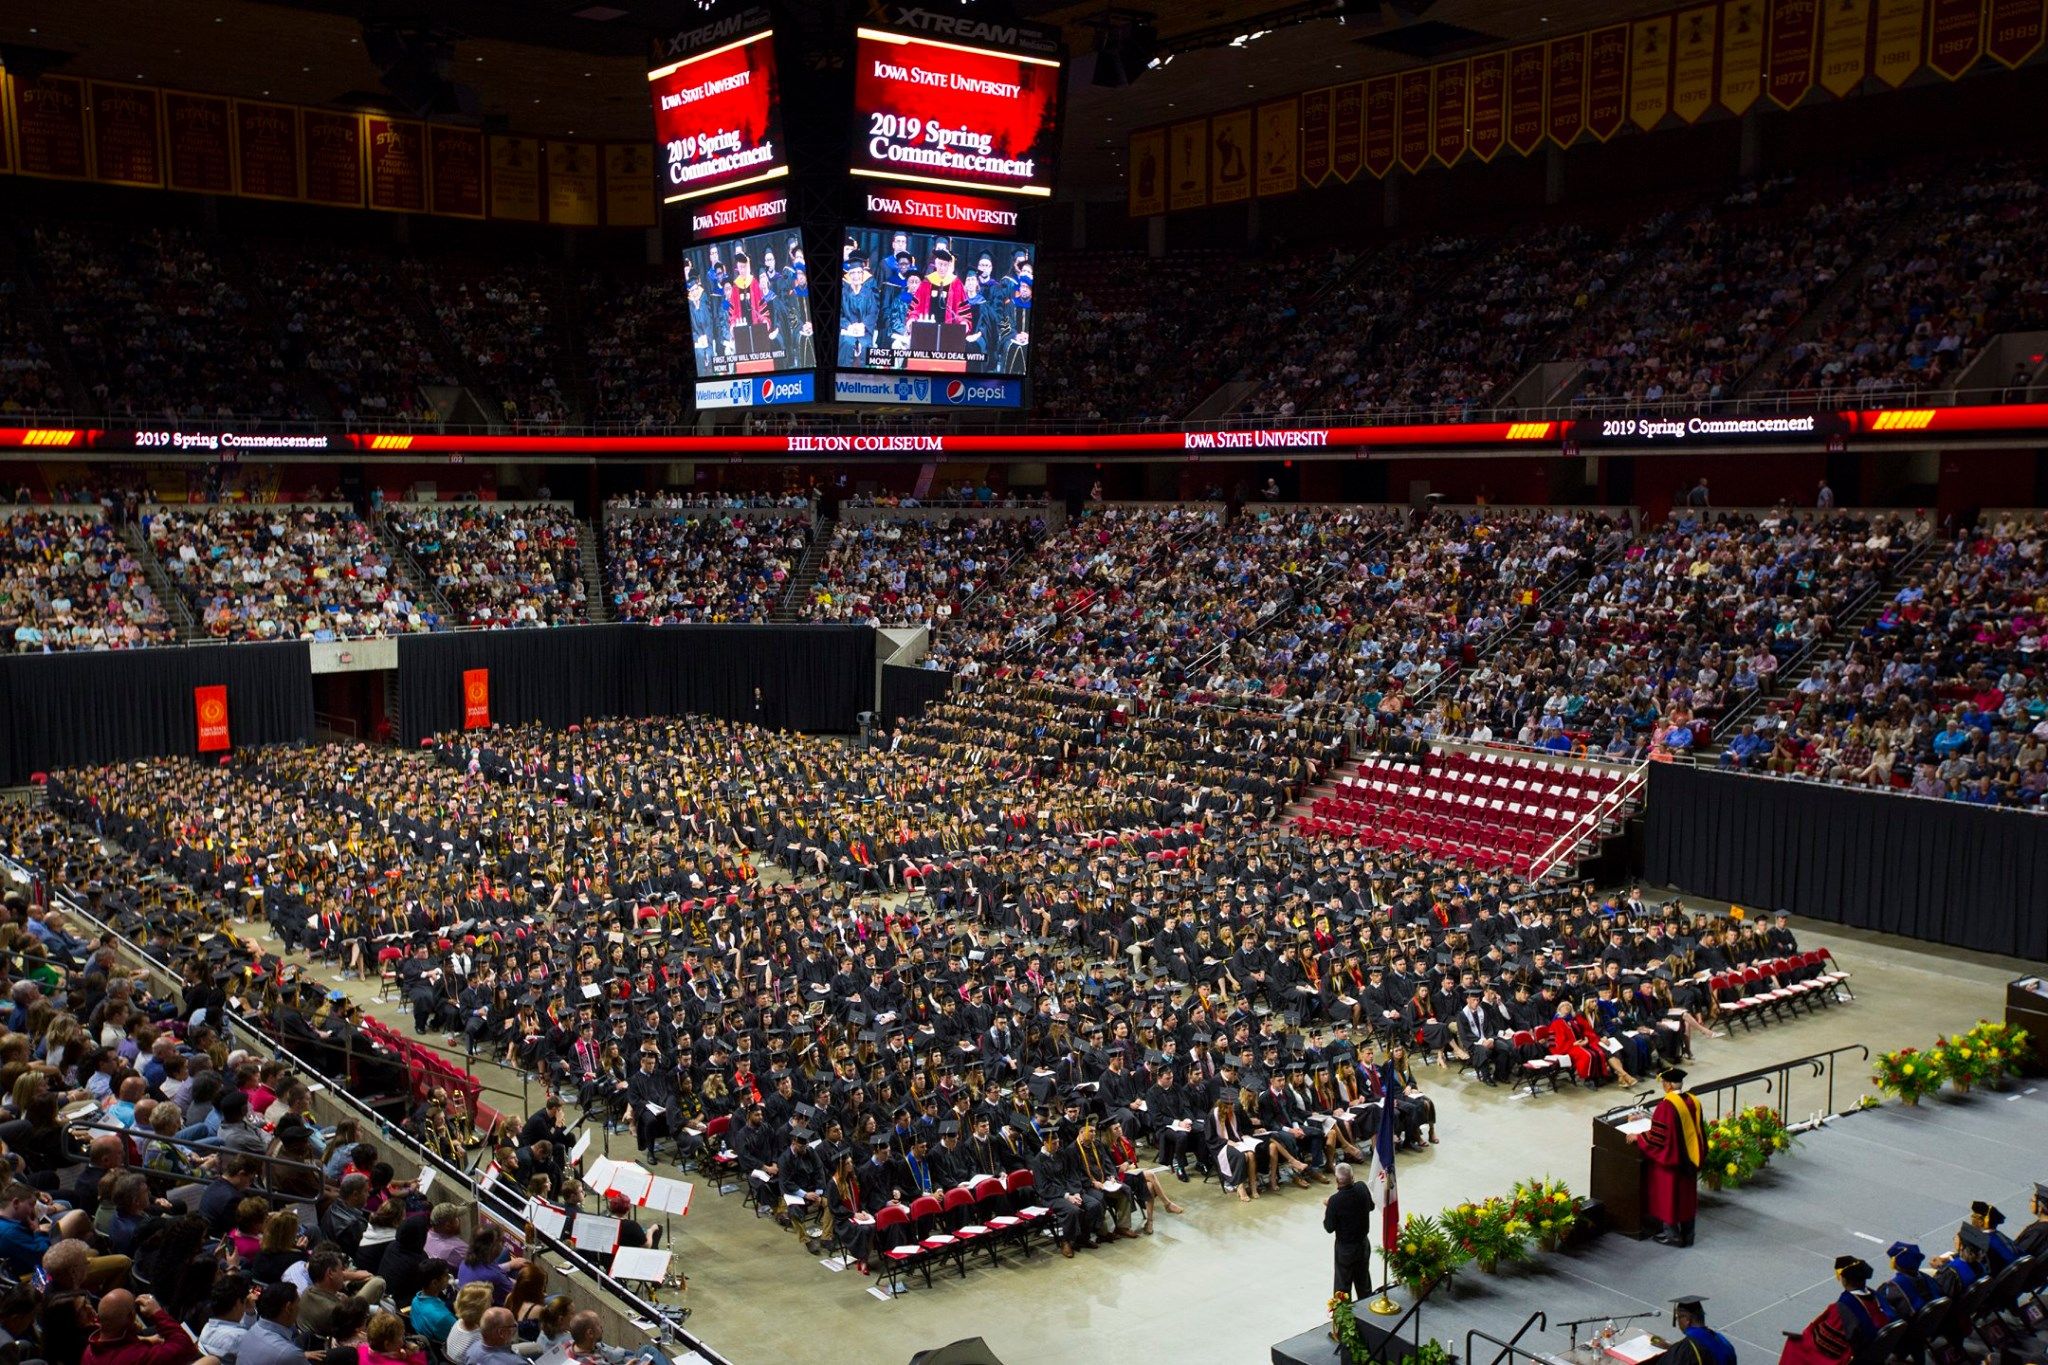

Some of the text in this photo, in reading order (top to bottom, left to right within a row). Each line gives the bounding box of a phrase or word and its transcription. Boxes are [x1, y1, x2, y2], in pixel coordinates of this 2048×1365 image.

[667, 13, 742, 56] XTREAM
[894, 7, 1018, 46] XTREAM
[1998, 24, 2039, 42] 1989
[1938, 36, 1974, 55] 1987
[874, 60, 1021, 99] IOWA STATE UNIVERSITY
[1774, 71, 1806, 87] 1977
[661, 70, 751, 111] IOWA STATE UNIVERSITY
[869, 112, 993, 155] 2019 Spring
[667, 128, 742, 164] 2019 Spring
[670, 140, 774, 184] Commencement
[869, 137, 1035, 178] Commencement
[692, 198, 787, 231] IOWA STATE UNIVERSITY
[867, 194, 1018, 226] IOWA STATE UNIVERSITY
[869, 348, 985, 361] FIRST, HOW WILL YOU DEAL WITH
[696, 387, 728, 401] Wellmark
[776, 380, 803, 399] pepsi
[835, 380, 889, 395] Wellmark
[967, 385, 1005, 402] pepsi
[1602, 416, 1814, 438] 2019 Spring Commencement
[135, 431, 328, 450] 2019 Spring Commencement
[787, 435, 944, 452] HILTON COLISEUM
[1184, 430, 1329, 449] IOWA STATE UNIVERSITY
